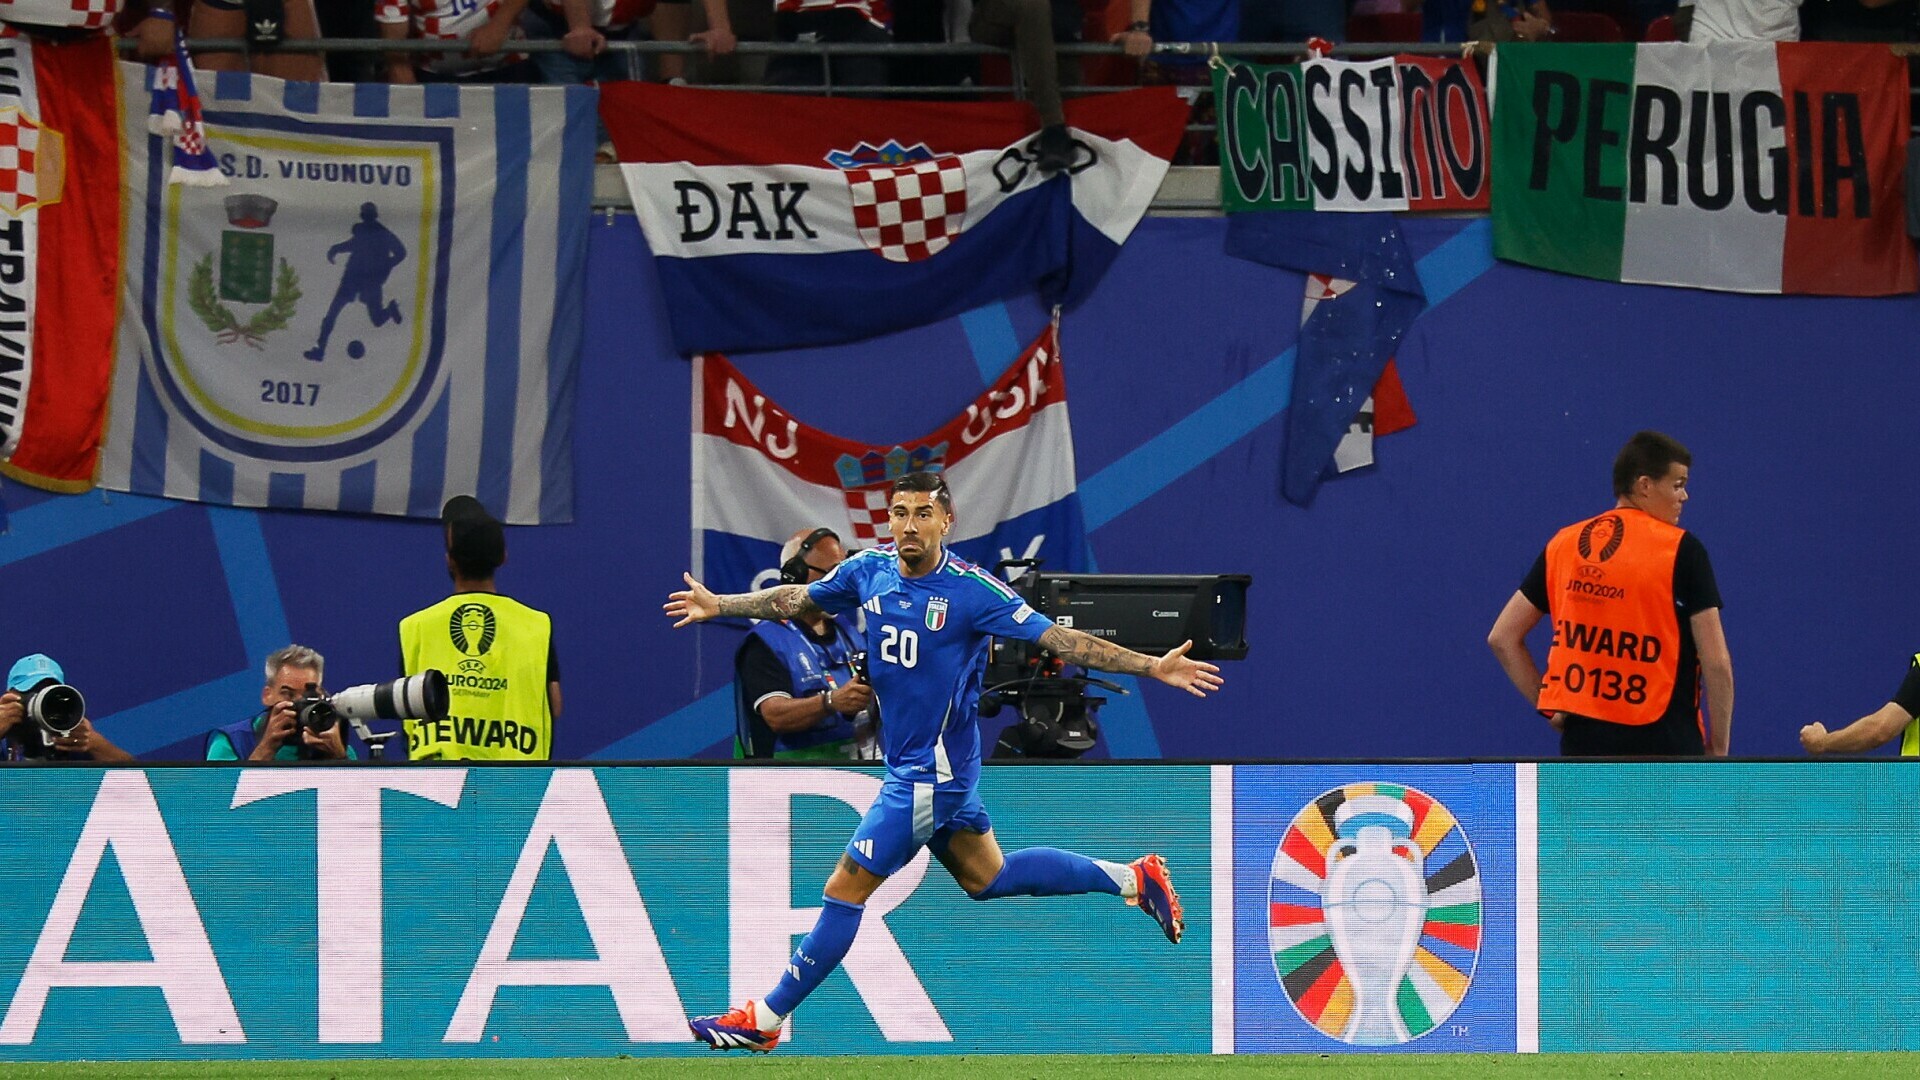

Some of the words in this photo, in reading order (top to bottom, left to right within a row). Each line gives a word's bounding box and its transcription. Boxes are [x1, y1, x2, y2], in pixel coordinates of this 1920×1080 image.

[1529, 70, 1872, 219] PERUGIA
[278, 159, 412, 187] VIGONOVO
[674, 180, 818, 242] ĐAK
[261, 380, 321, 406] 2017
[880, 624, 919, 669] 20
[1540, 663, 1648, 705] -0138
[0, 769, 954, 1044] ATAR
